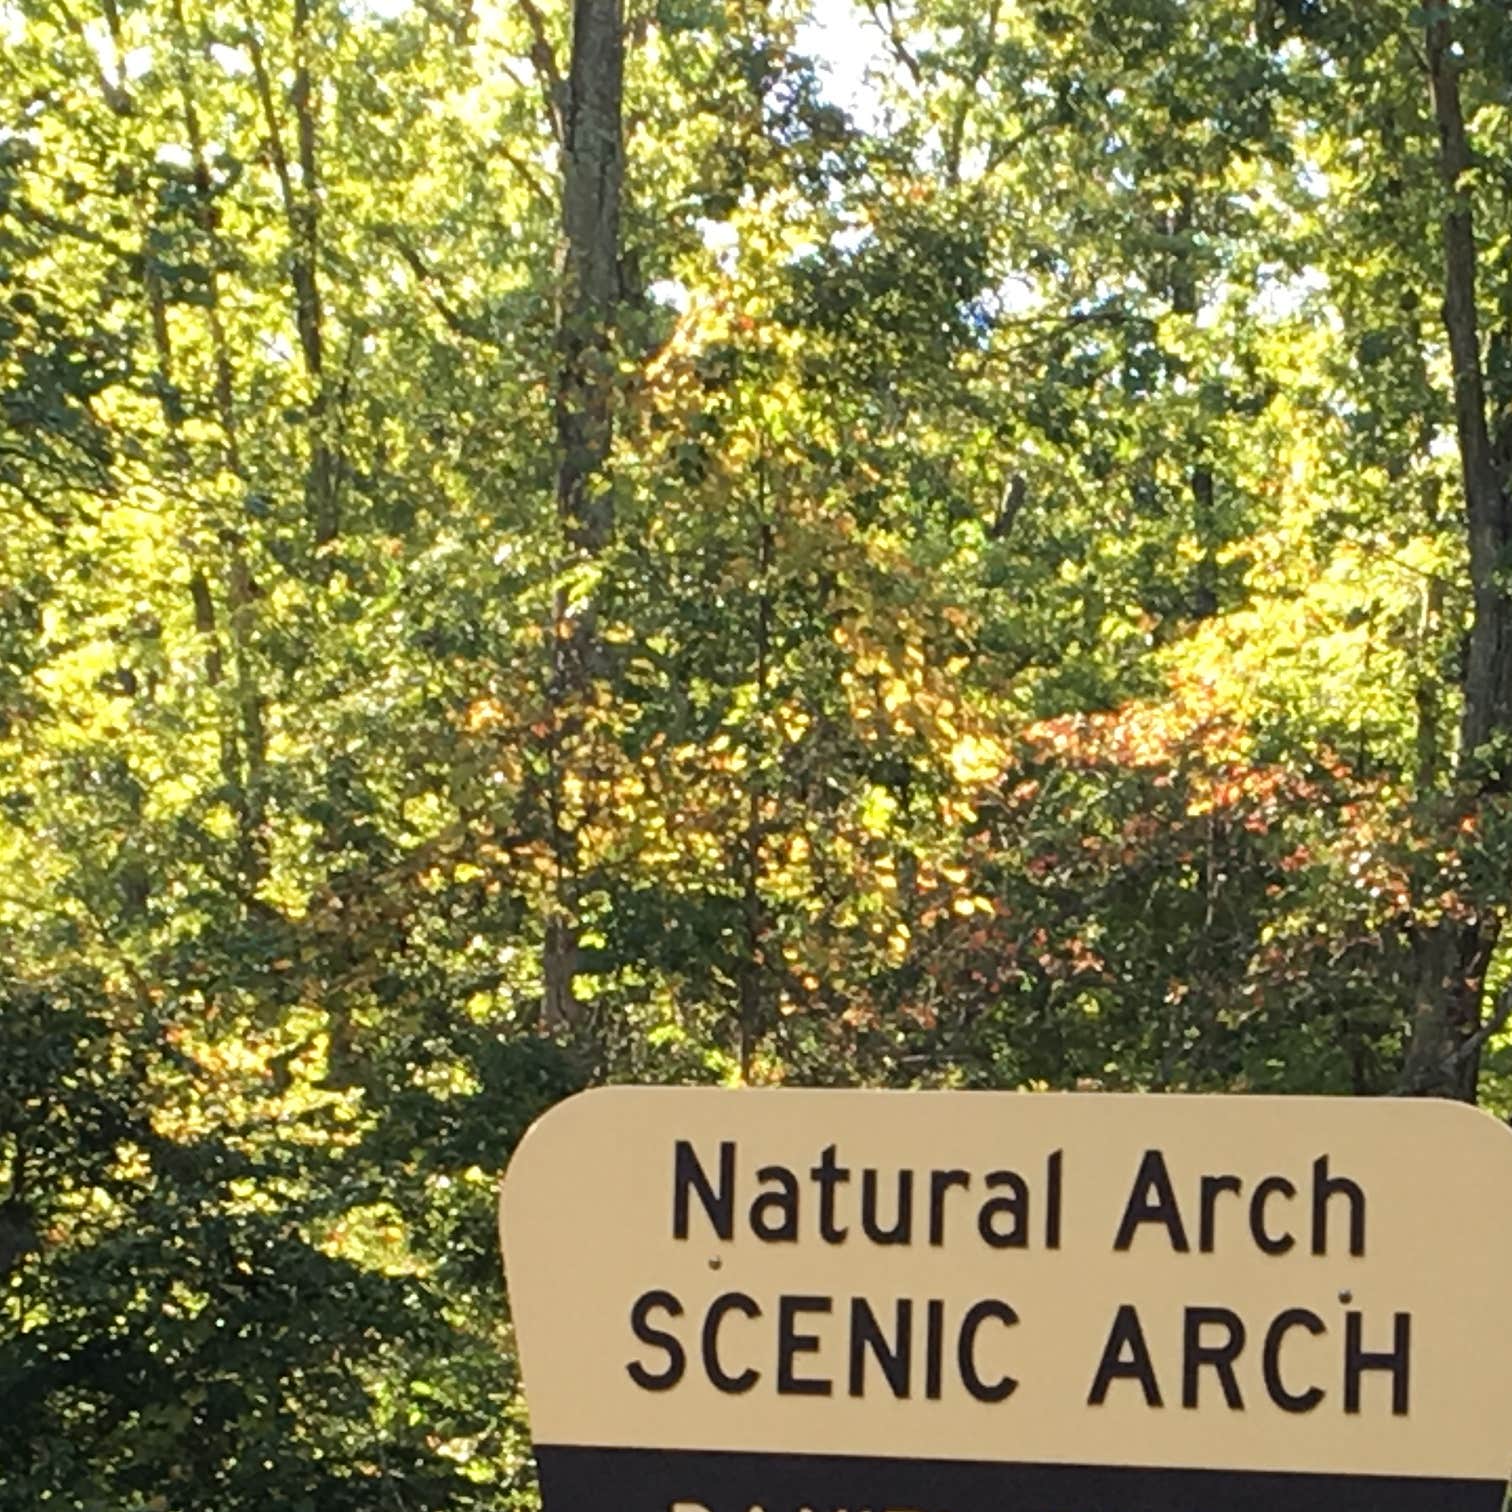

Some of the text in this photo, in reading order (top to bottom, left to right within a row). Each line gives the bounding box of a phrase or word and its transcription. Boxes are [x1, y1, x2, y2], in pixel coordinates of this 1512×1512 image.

[673, 1140, 1366, 1258] Natural Arch
[625, 1290, 1411, 1417] SCENIC ARCH
